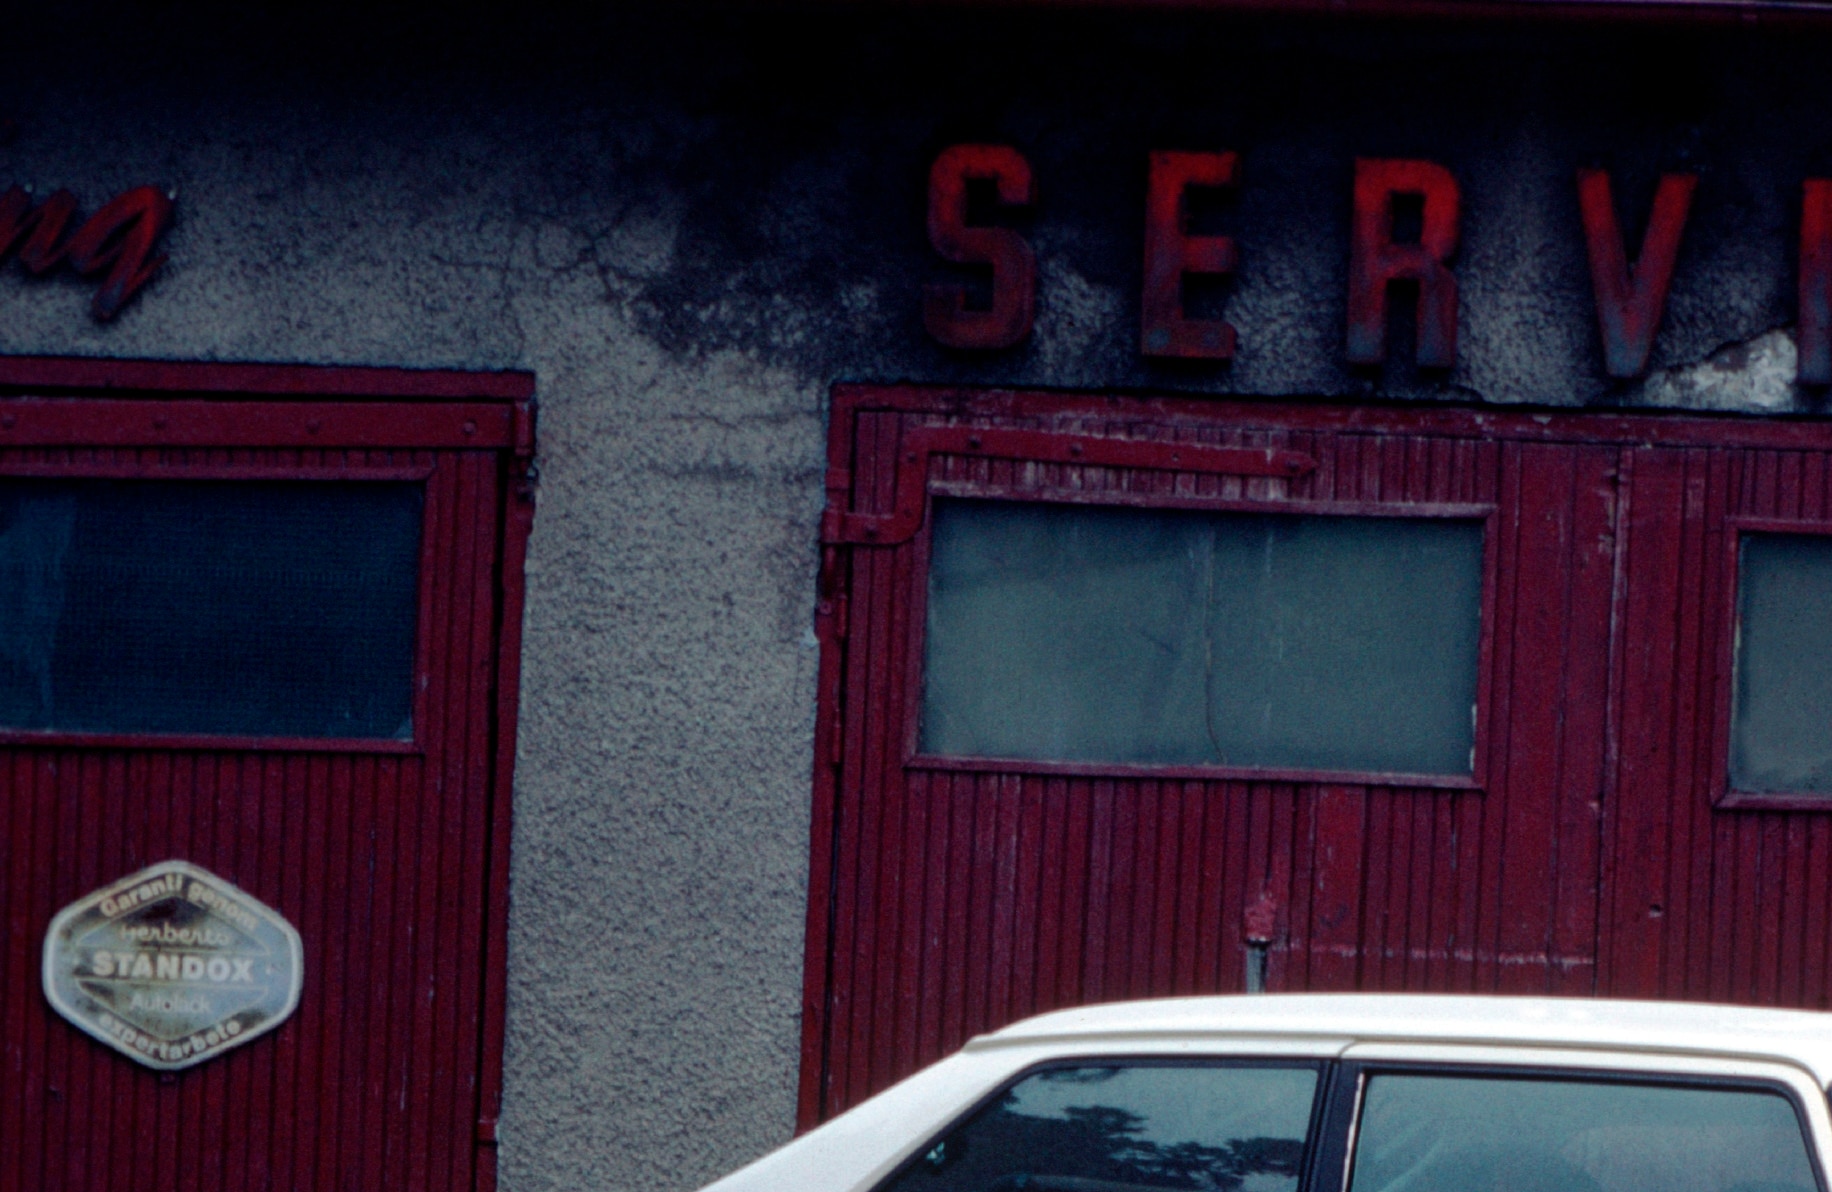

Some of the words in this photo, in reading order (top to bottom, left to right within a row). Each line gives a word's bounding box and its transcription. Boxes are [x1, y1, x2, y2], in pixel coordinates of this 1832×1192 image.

[0, 184, 175, 322] ng
[100, 873, 183, 917] Garanti
[92, 950, 254, 983] STANDOX
